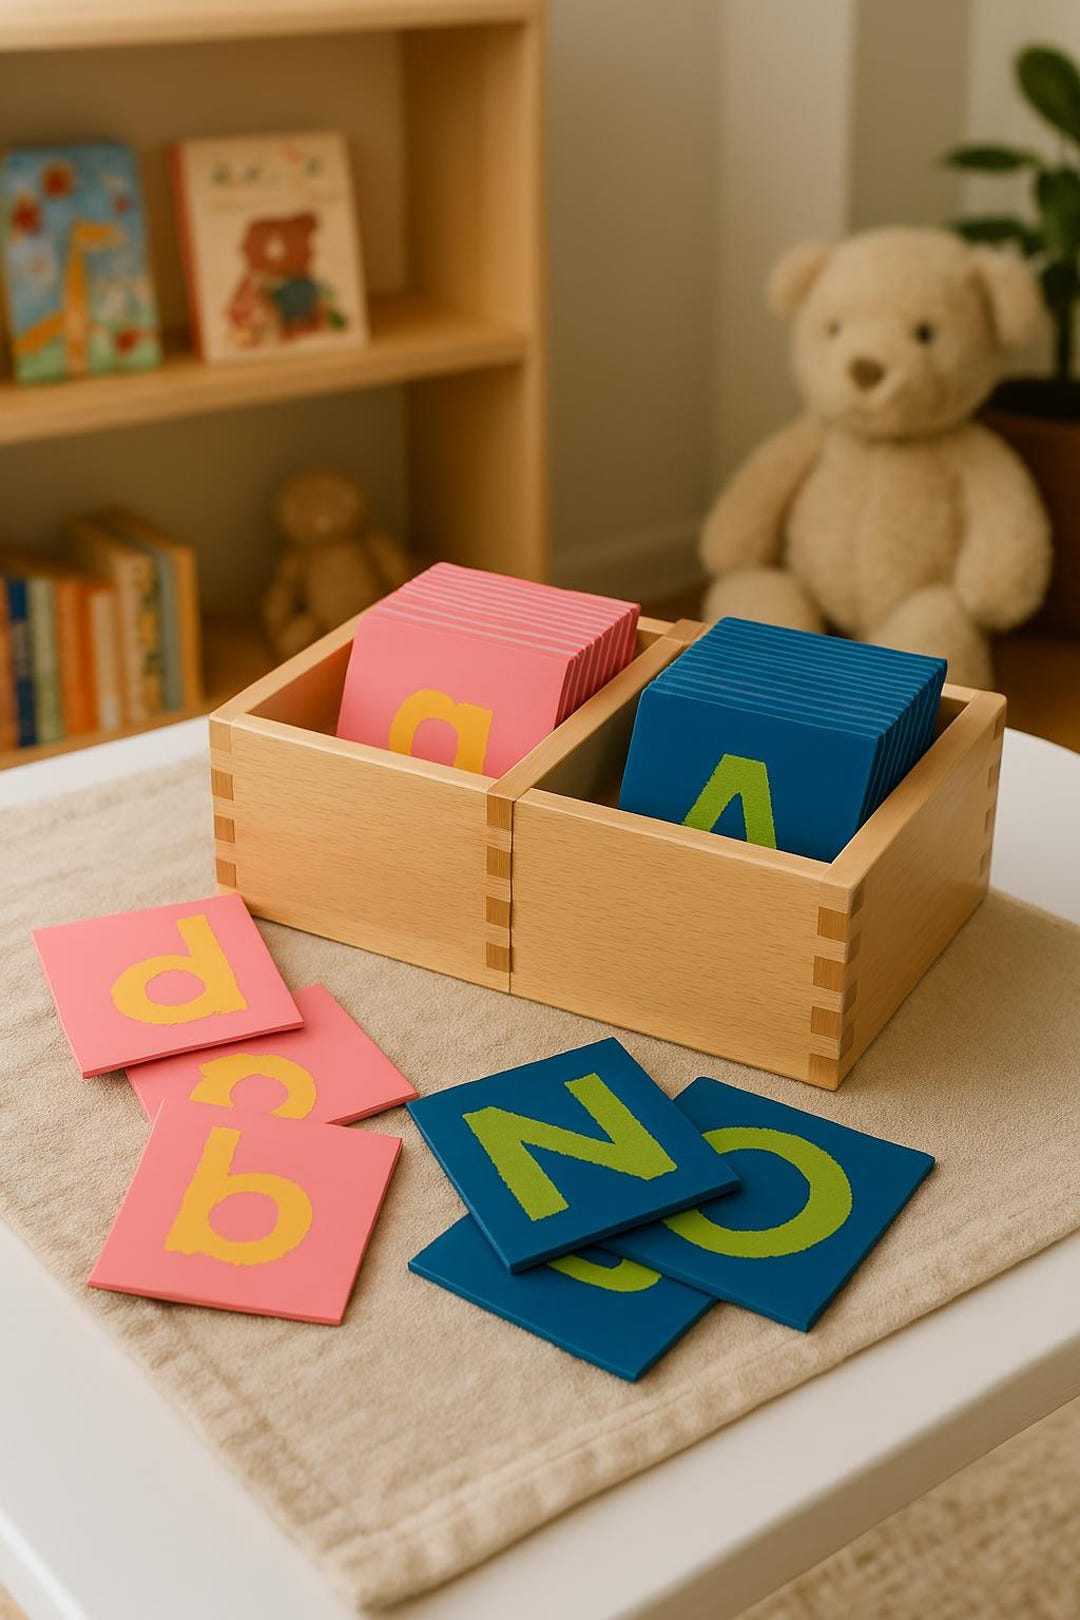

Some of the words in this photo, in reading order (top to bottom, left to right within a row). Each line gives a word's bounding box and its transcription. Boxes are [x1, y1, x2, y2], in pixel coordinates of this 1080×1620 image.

[111, 914, 247, 1024] d
[165, 1126, 313, 1266] b
[463, 1072, 677, 1222] N
